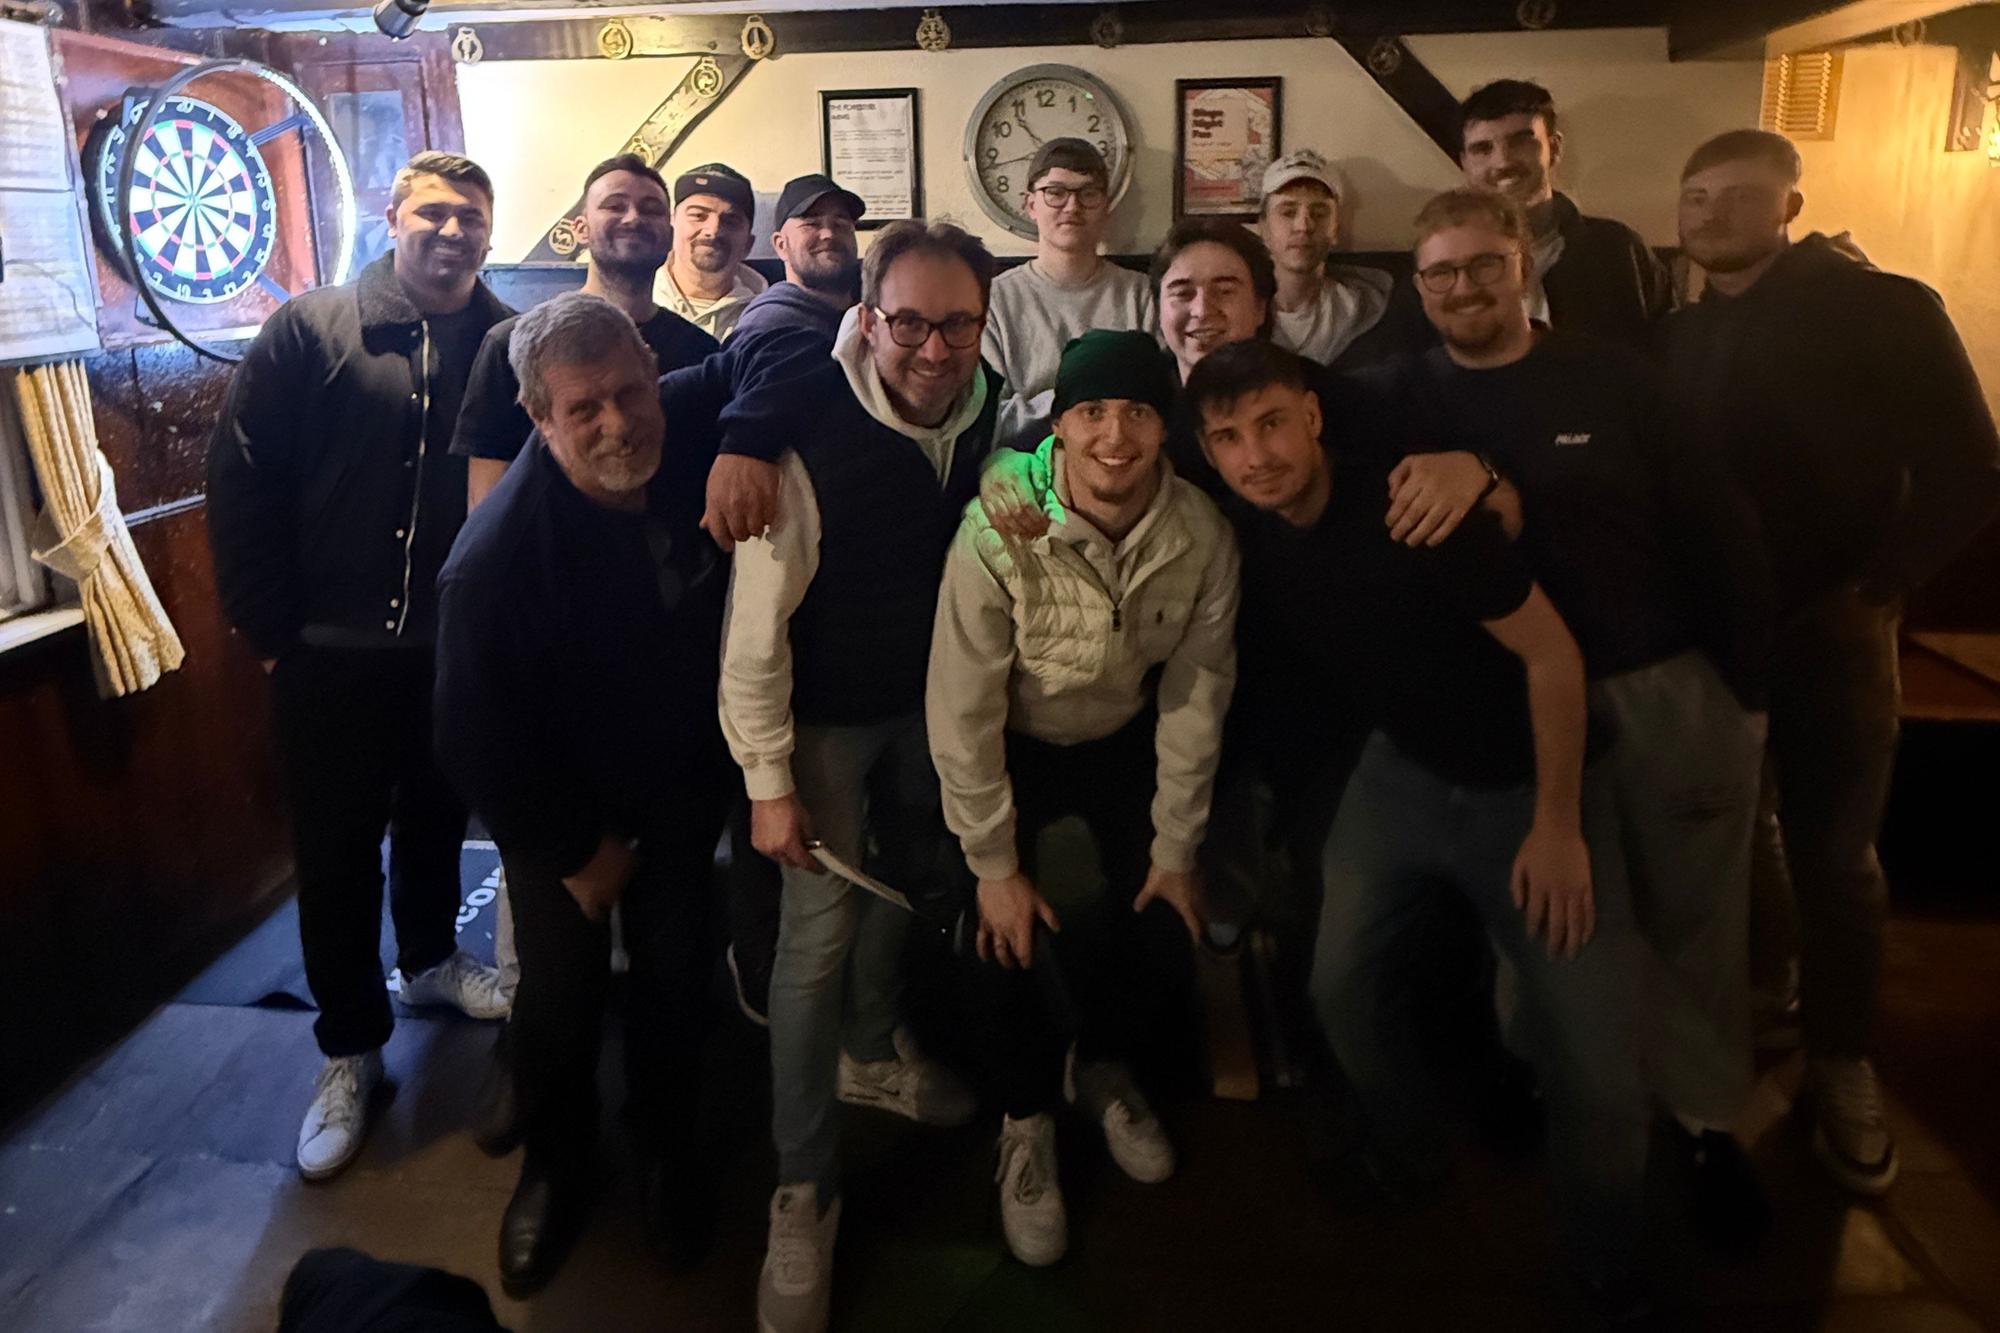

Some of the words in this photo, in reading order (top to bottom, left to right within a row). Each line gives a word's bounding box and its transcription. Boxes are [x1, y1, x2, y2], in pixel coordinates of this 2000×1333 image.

[1035, 89, 1056, 108] 12
[1068, 96, 1077, 113] 1
[1011, 99, 1026, 117] 11
[992, 121, 1012, 138] 10
[1088, 114, 1100, 133] 2
[986, 147, 999, 167] 9
[1098, 140, 1109, 158] 3
[996, 175, 1010, 193] 8
